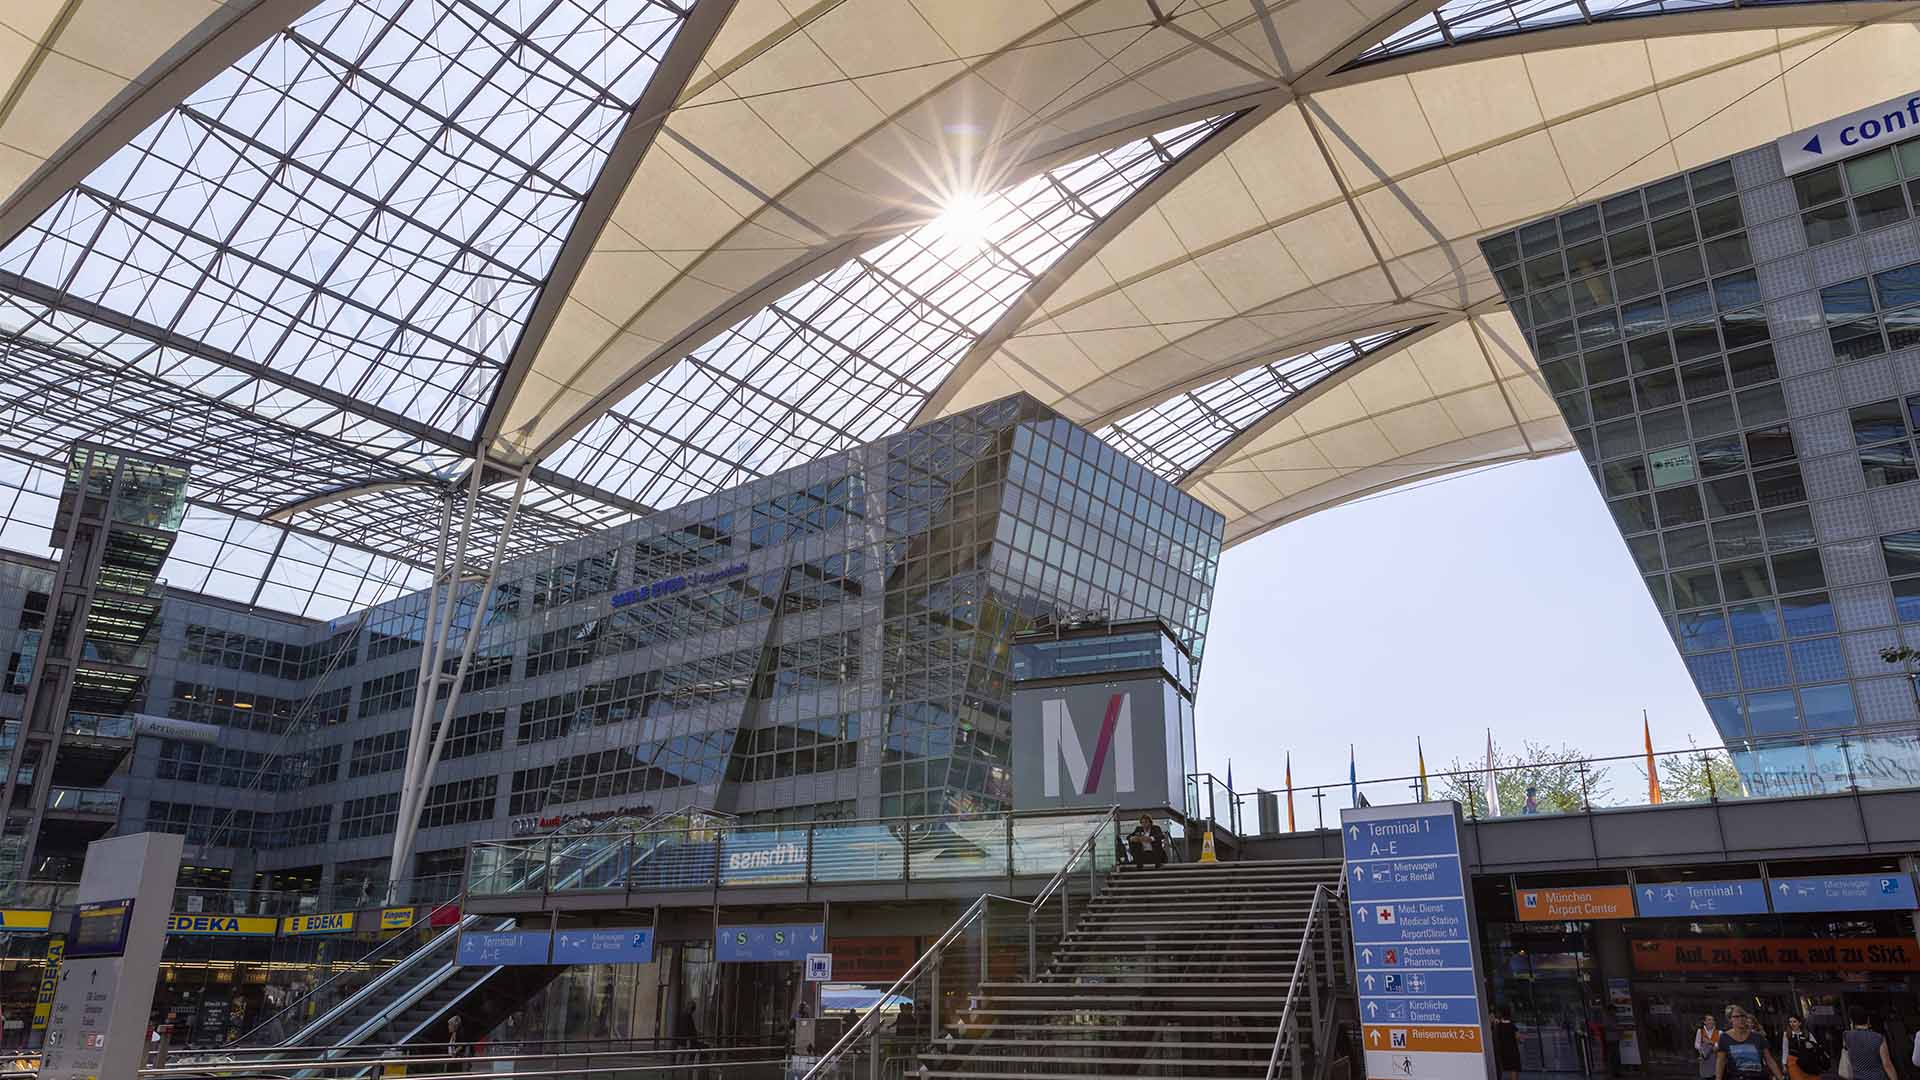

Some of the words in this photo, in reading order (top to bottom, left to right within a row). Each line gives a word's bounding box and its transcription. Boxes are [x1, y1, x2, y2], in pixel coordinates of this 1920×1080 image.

[539, 816, 561, 827] Audi
[1368, 820, 1420, 836] Terminal
[1424, 820, 1431, 833] 1
[1394, 862, 1437, 873] Mietwagen
[1395, 874, 1408, 882] Car
[1410, 872, 1435, 881] Rental
[1881, 880, 1889, 890] P
[1687, 885, 1733, 897] Terminal
[1737, 885, 1743, 896] 1
[1545, 892, 1592, 903] München
[1420, 904, 1444, 912] Dienst
[1549, 904, 1581, 916] Airport
[1584, 903, 1617, 913] Center
[168, 917, 240, 932] EDEKA
[292, 918, 299, 931] E
[306, 915, 343, 930] EDEKA
[1400, 917, 1429, 926] Medical
[1432, 915, 1458, 925] Station
[738, 932, 747, 944] S
[775, 931, 785, 944] S
[1449, 928, 1457, 937] M
[633, 934, 641, 944] P
[1403, 947, 1441, 956] Apotheke
[1404, 958, 1444, 968] Pharmacy
[40, 944, 63, 1003] EDEKA
[1385, 975, 1394, 988] P
[1409, 1001, 1448, 1011] Kirchliche
[1410, 1012, 1441, 1021] Dienste
[1412, 1028, 1457, 1039] Reisemarkt
